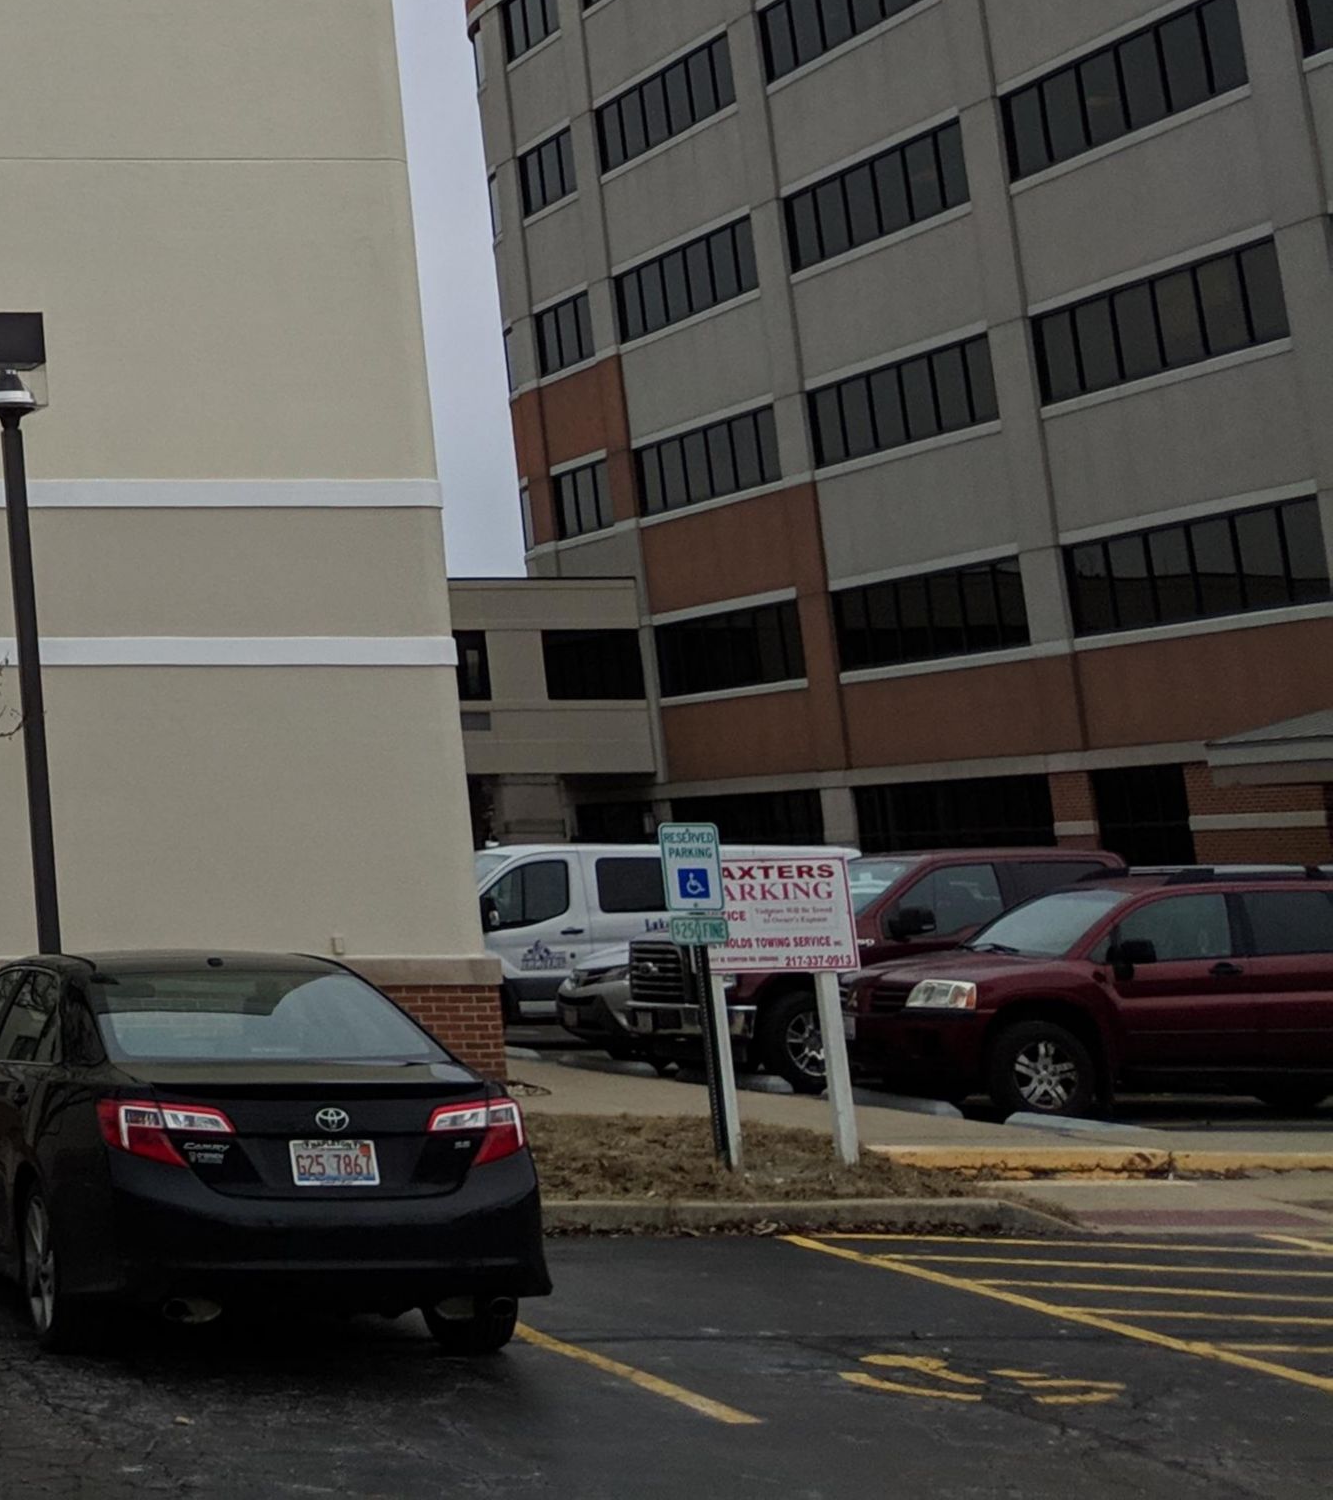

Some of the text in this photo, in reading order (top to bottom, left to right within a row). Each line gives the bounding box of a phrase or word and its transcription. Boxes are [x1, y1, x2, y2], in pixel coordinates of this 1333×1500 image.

[663, 831, 714, 844] RESERVED
[669, 847, 712, 859] PARKING
[722, 864, 835, 880] AXTERS
[724, 881, 833, 901] ARKING
[675, 922, 725, 939] $250 FINE
[754, 937, 790, 948] TOWING
[794, 936, 831, 947] SERVICE
[785, 955, 852, 966] 217-337-0913
